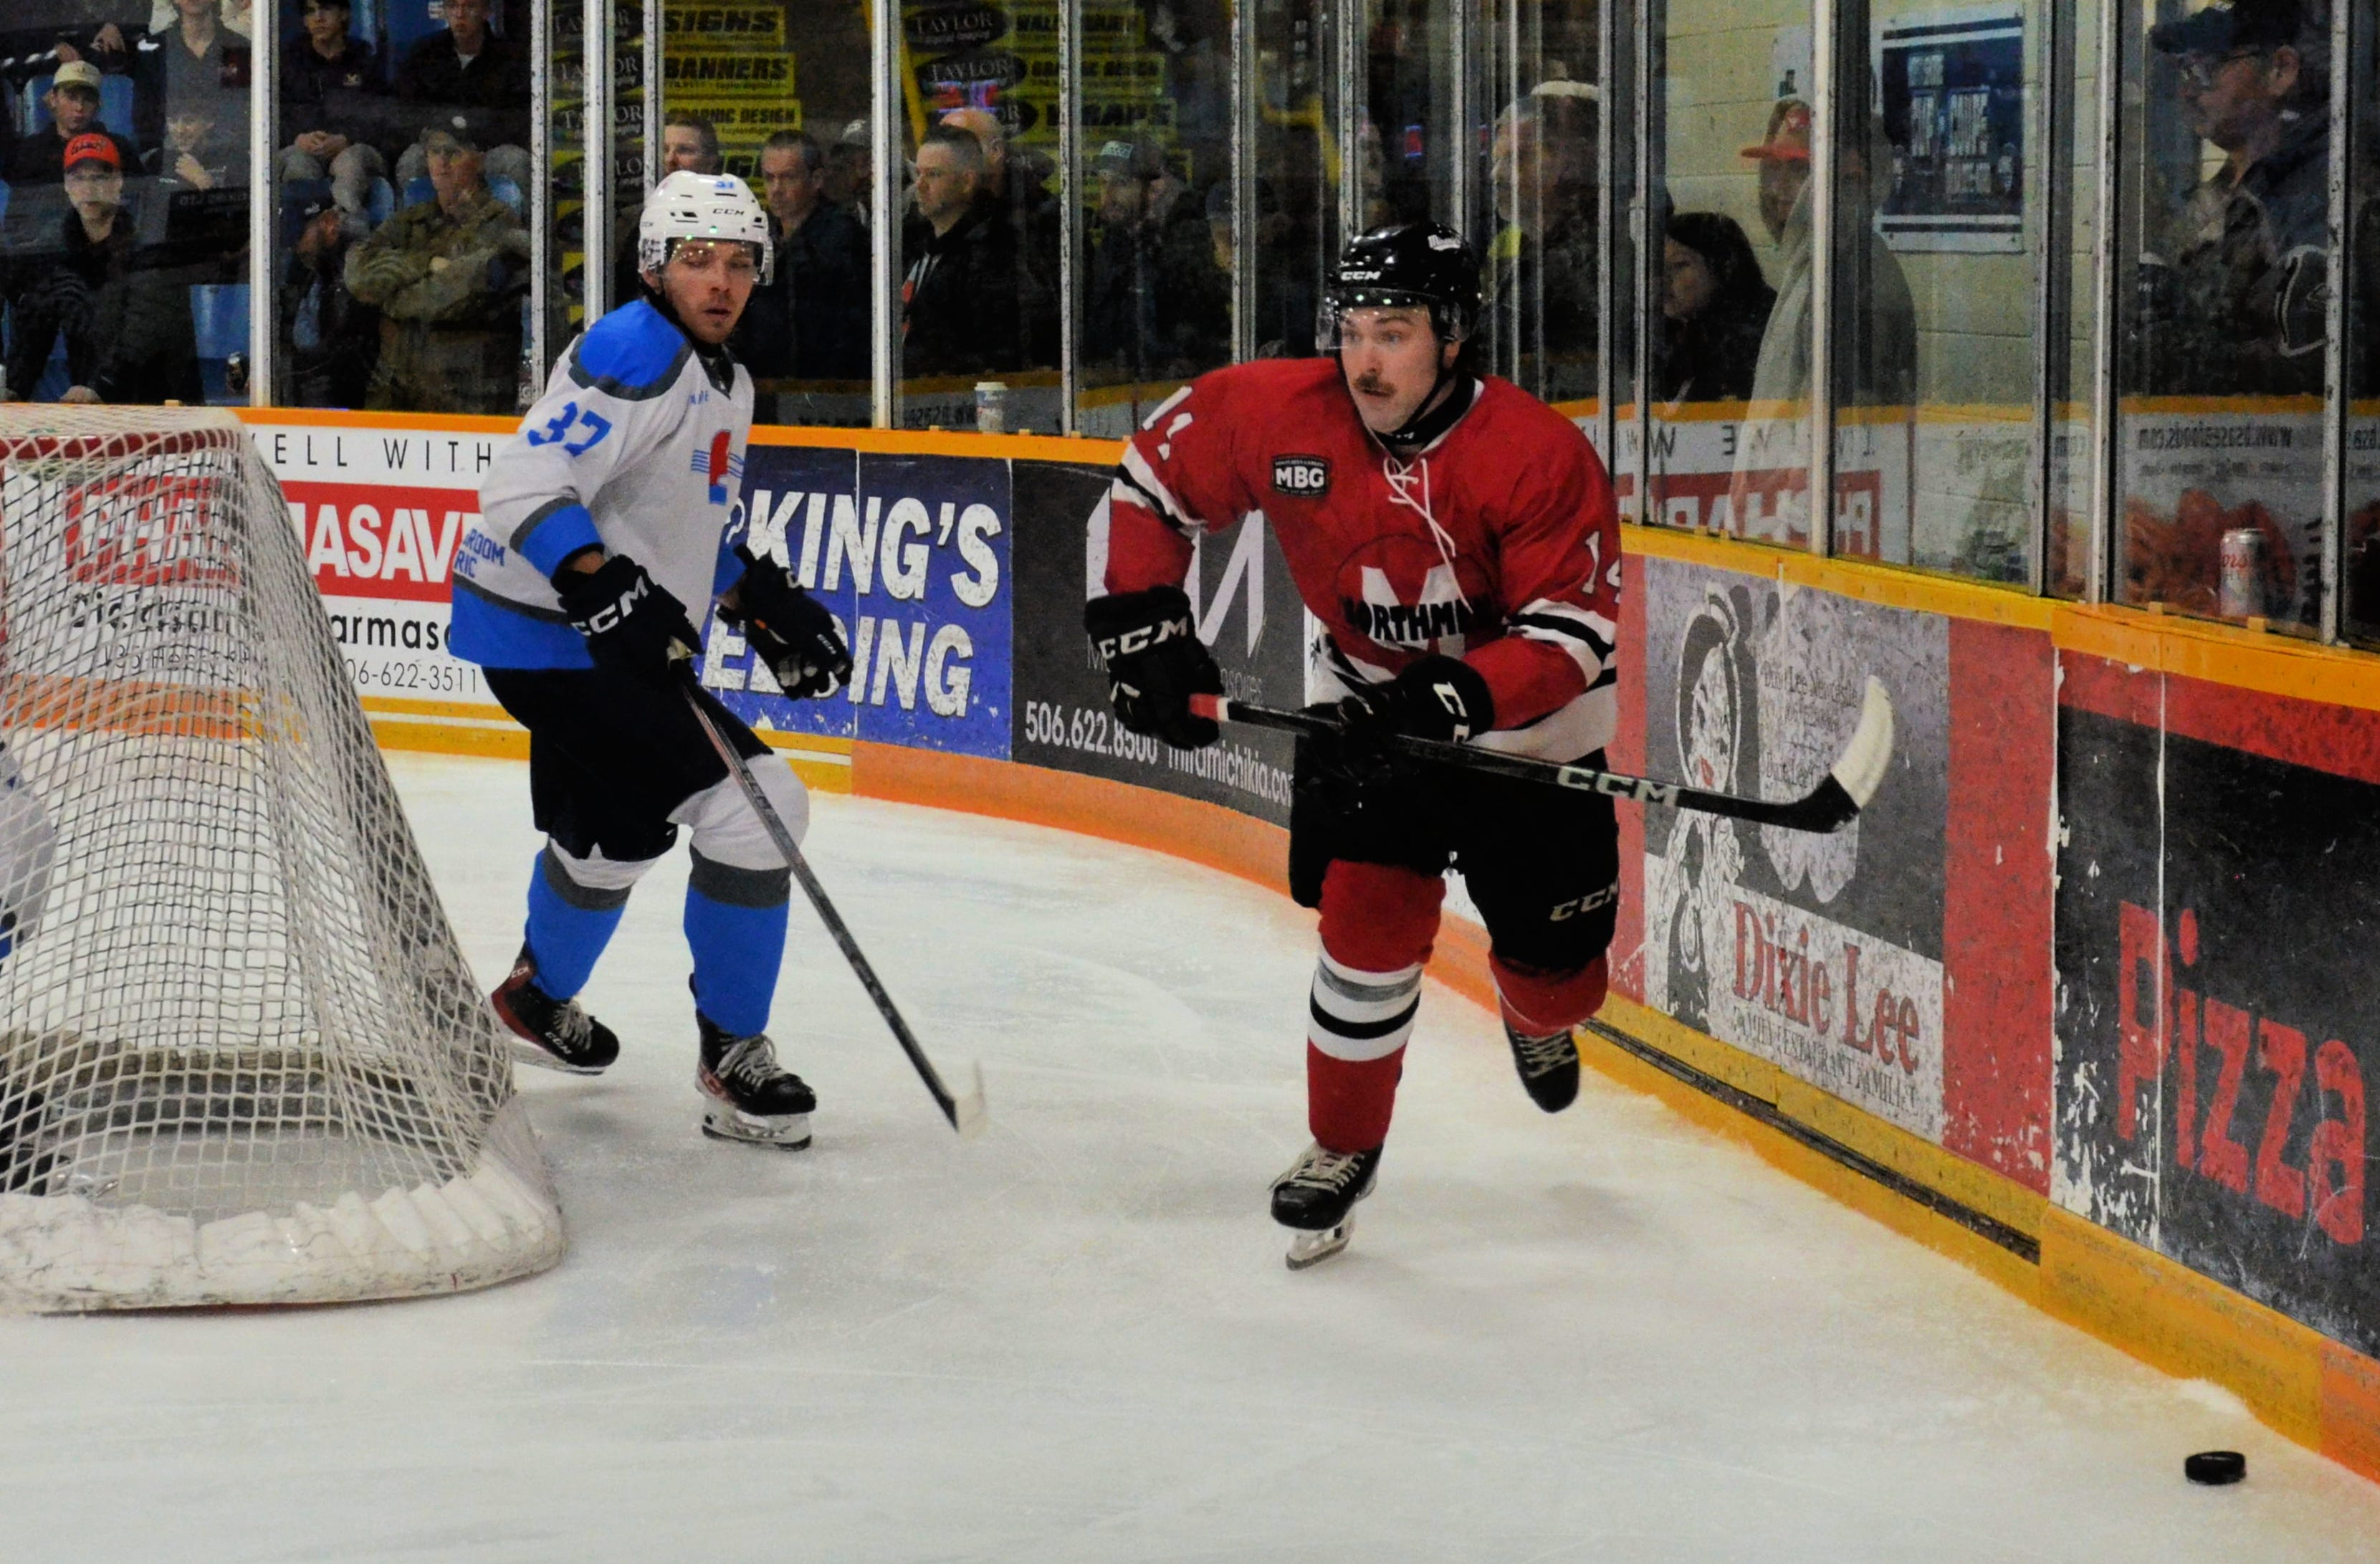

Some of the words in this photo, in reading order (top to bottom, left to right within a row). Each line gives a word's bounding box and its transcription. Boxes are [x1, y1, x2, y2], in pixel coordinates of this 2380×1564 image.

[664, 9, 779, 33] SIGNS
[916, 11, 993, 35] TAYLOR
[664, 56, 789, 80] BANNERS
[932, 58, 1010, 81] TAYLOR
[1341, 271, 1382, 280] CCM
[527, 401, 613, 457] 37
[383, 438, 491, 473] WITH
[1275, 466, 1325, 490] MBG
[570, 575, 649, 636] CCM
[1098, 616, 1188, 661] CCM
[344, 658, 477, 693] 06-622-3511
[1557, 765, 1680, 809] CCM
[1732, 900, 1831, 1036] Dixie
[1843, 941, 1920, 1075] Lee
[2118, 900, 2366, 1245] Pizza
